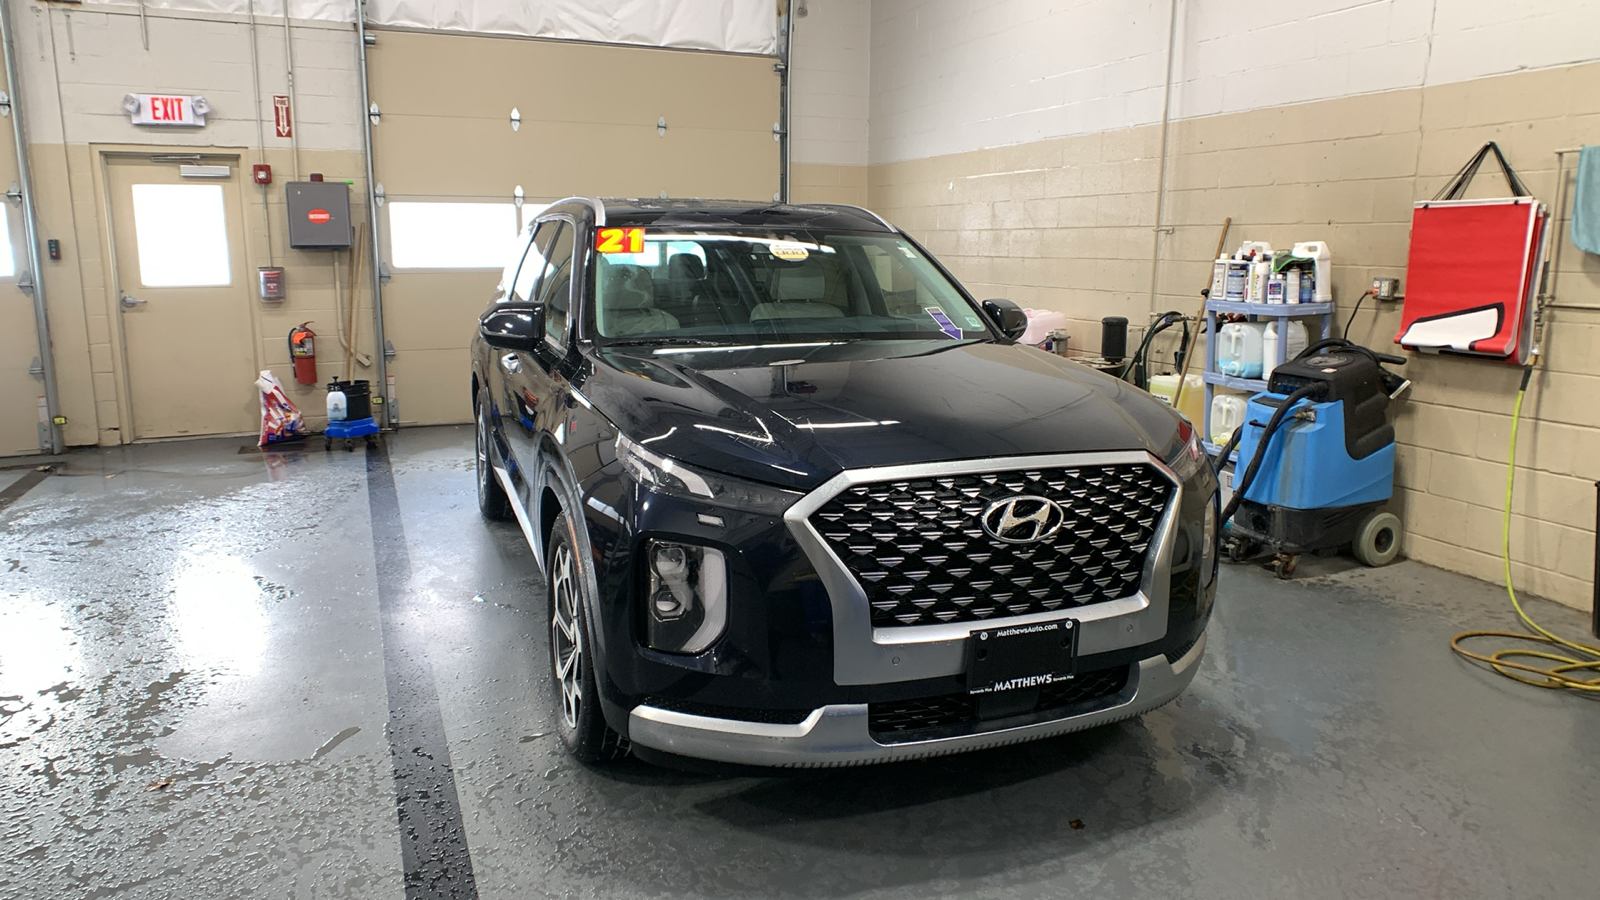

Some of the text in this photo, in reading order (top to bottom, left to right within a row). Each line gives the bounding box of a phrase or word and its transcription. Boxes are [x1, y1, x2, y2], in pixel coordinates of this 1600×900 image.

[150, 97, 183, 121] EXIT
[598, 228, 643, 253] 21
[996, 623, 1058, 638] MatthewsAuto.com
[994, 673, 1053, 692] MATTHEWS
